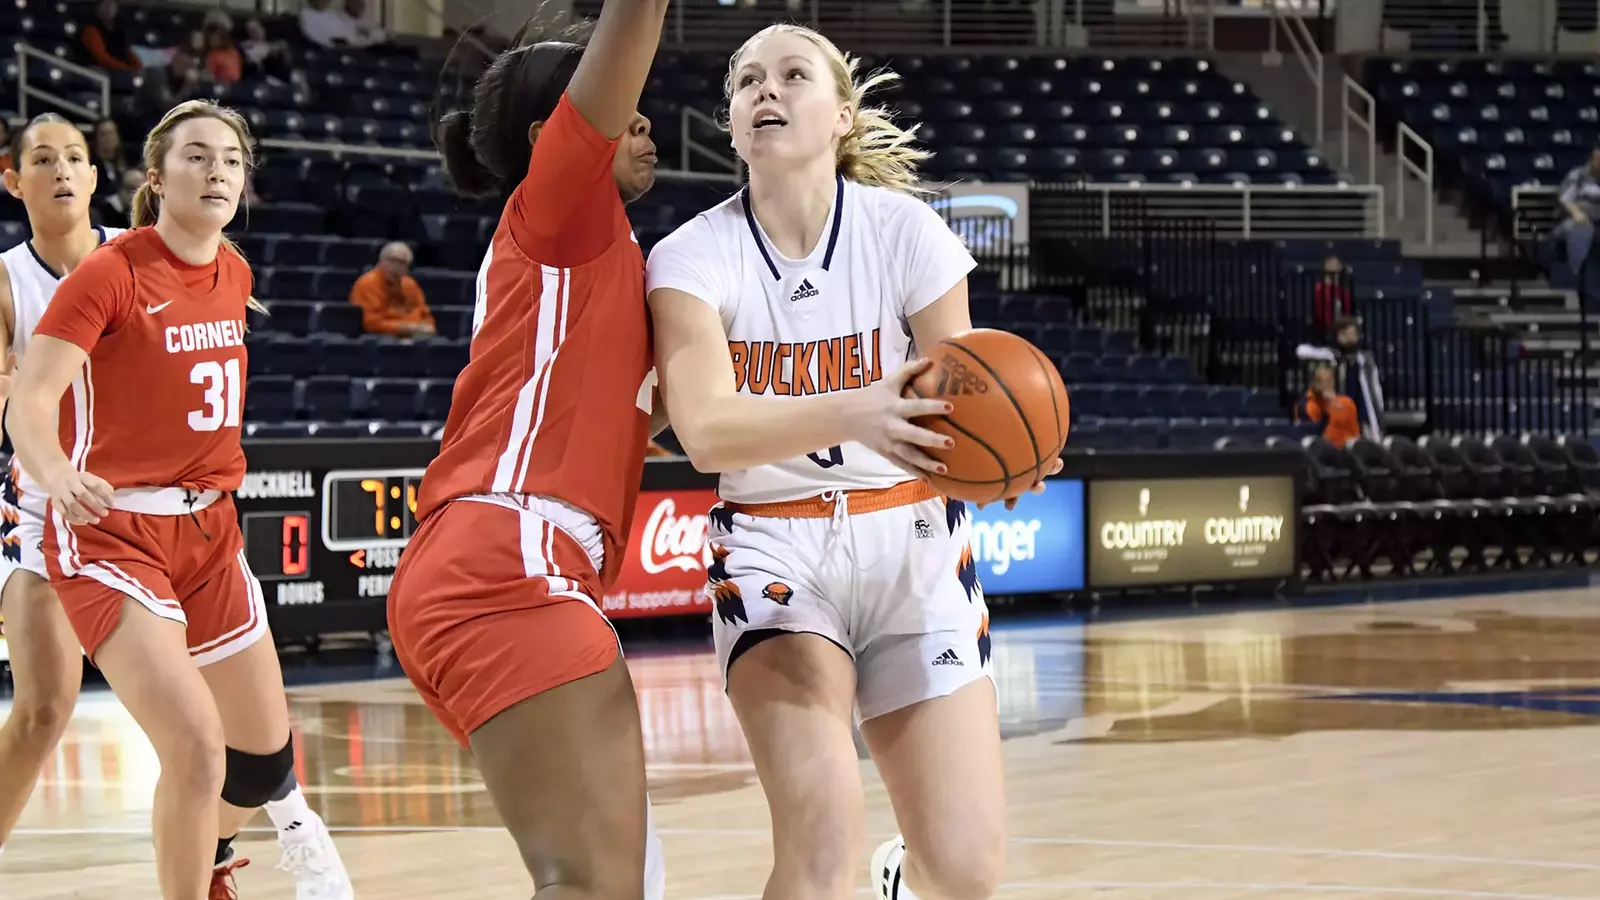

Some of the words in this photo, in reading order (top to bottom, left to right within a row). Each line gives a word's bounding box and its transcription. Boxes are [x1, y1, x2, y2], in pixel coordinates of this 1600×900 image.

[790, 288, 819, 302] adidas
[187, 358, 240, 431] 31
[282, 515, 308, 575] 0
[1101, 519, 1187, 550] COUNTRY
[1204, 515, 1284, 545] COUNTRY
[277, 580, 325, 605] BONUS
[931, 658, 964, 667] adidas
